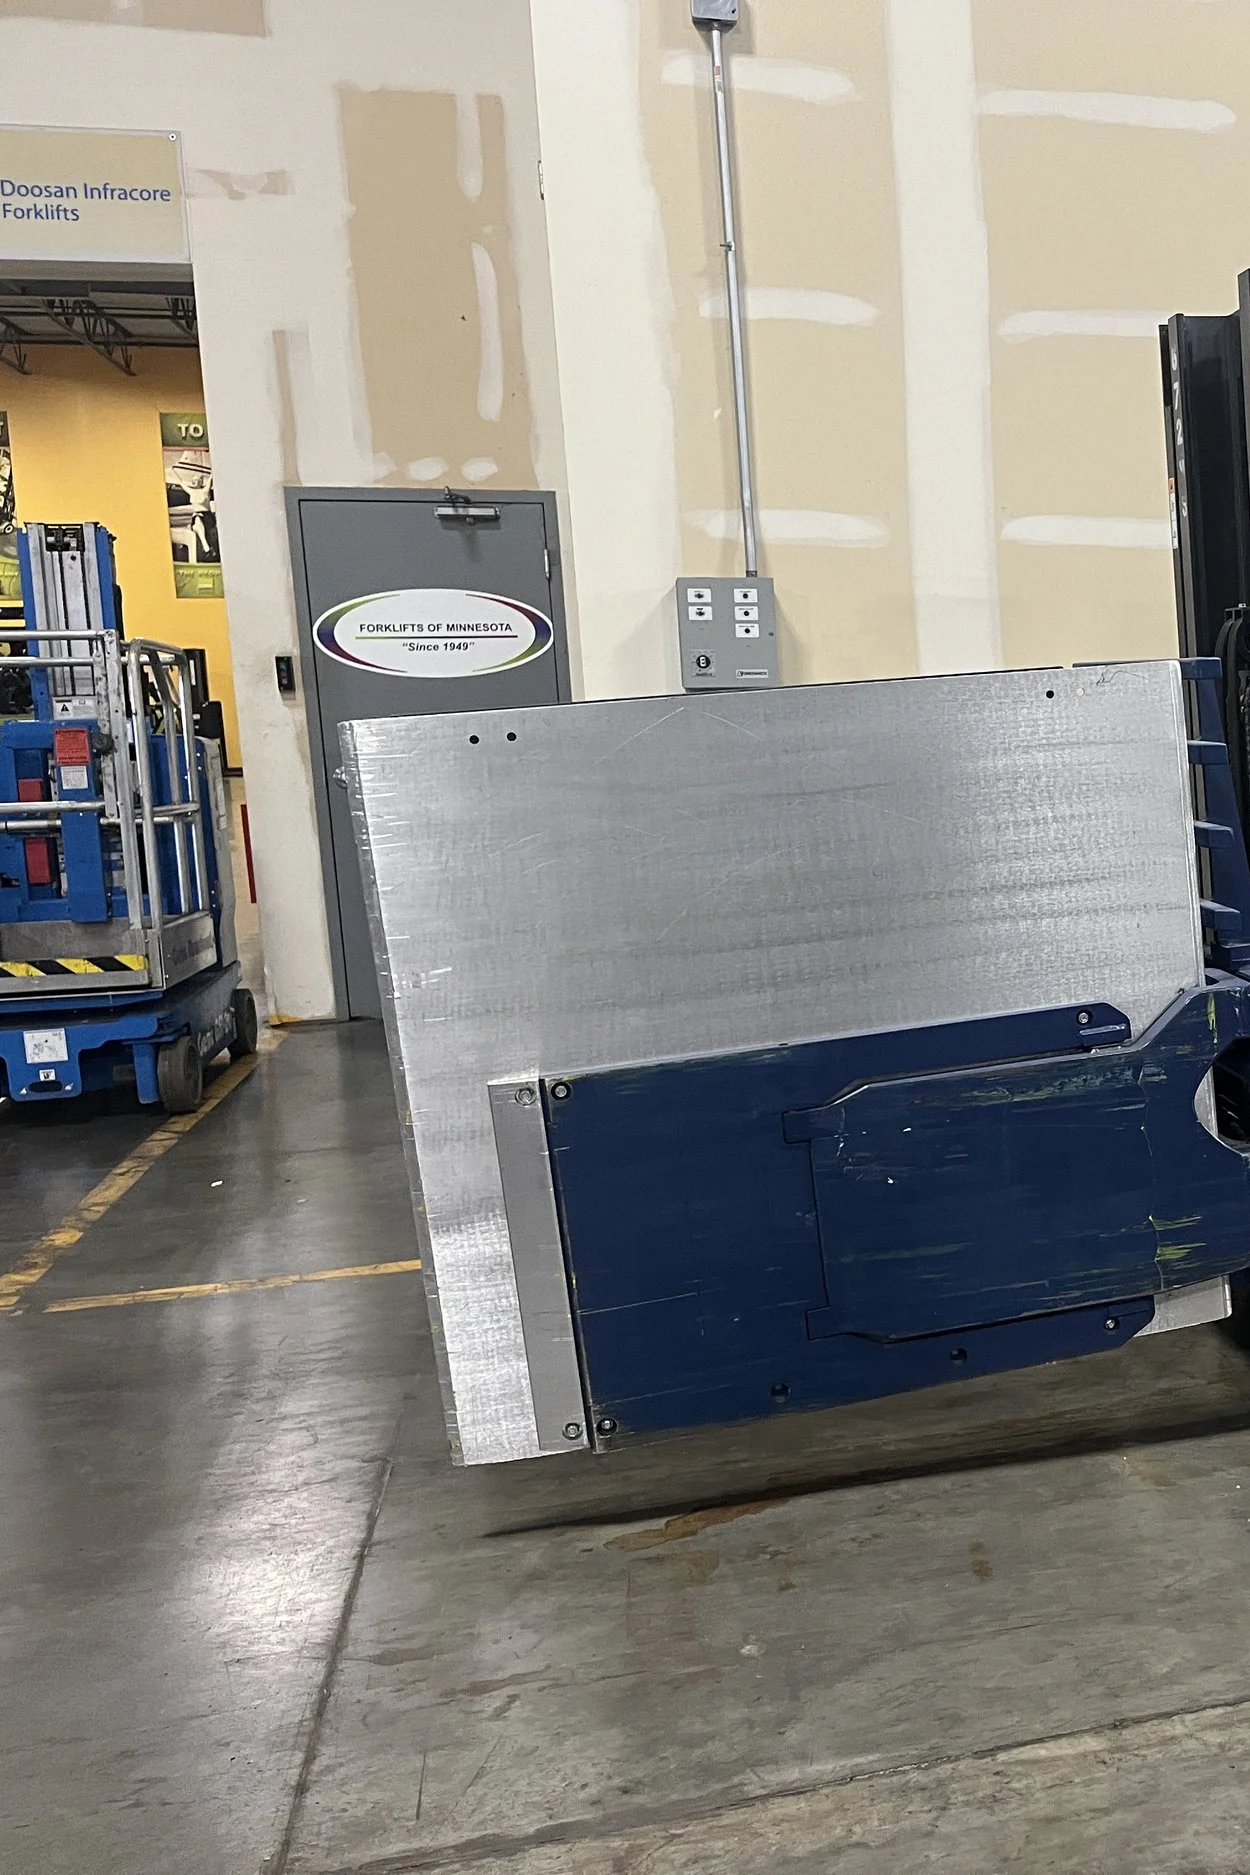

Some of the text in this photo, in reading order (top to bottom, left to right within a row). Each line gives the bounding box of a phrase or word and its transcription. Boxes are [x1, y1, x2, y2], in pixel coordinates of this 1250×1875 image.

[0, 179, 171, 202] Doosan Infracore
[2, 203, 80, 221] Forklifts
[177, 422, 204, 438] TO
[359, 623, 512, 633] FORKLIFTS OF MINNESOTA
[402, 641, 475, 652] “Since 1949”
